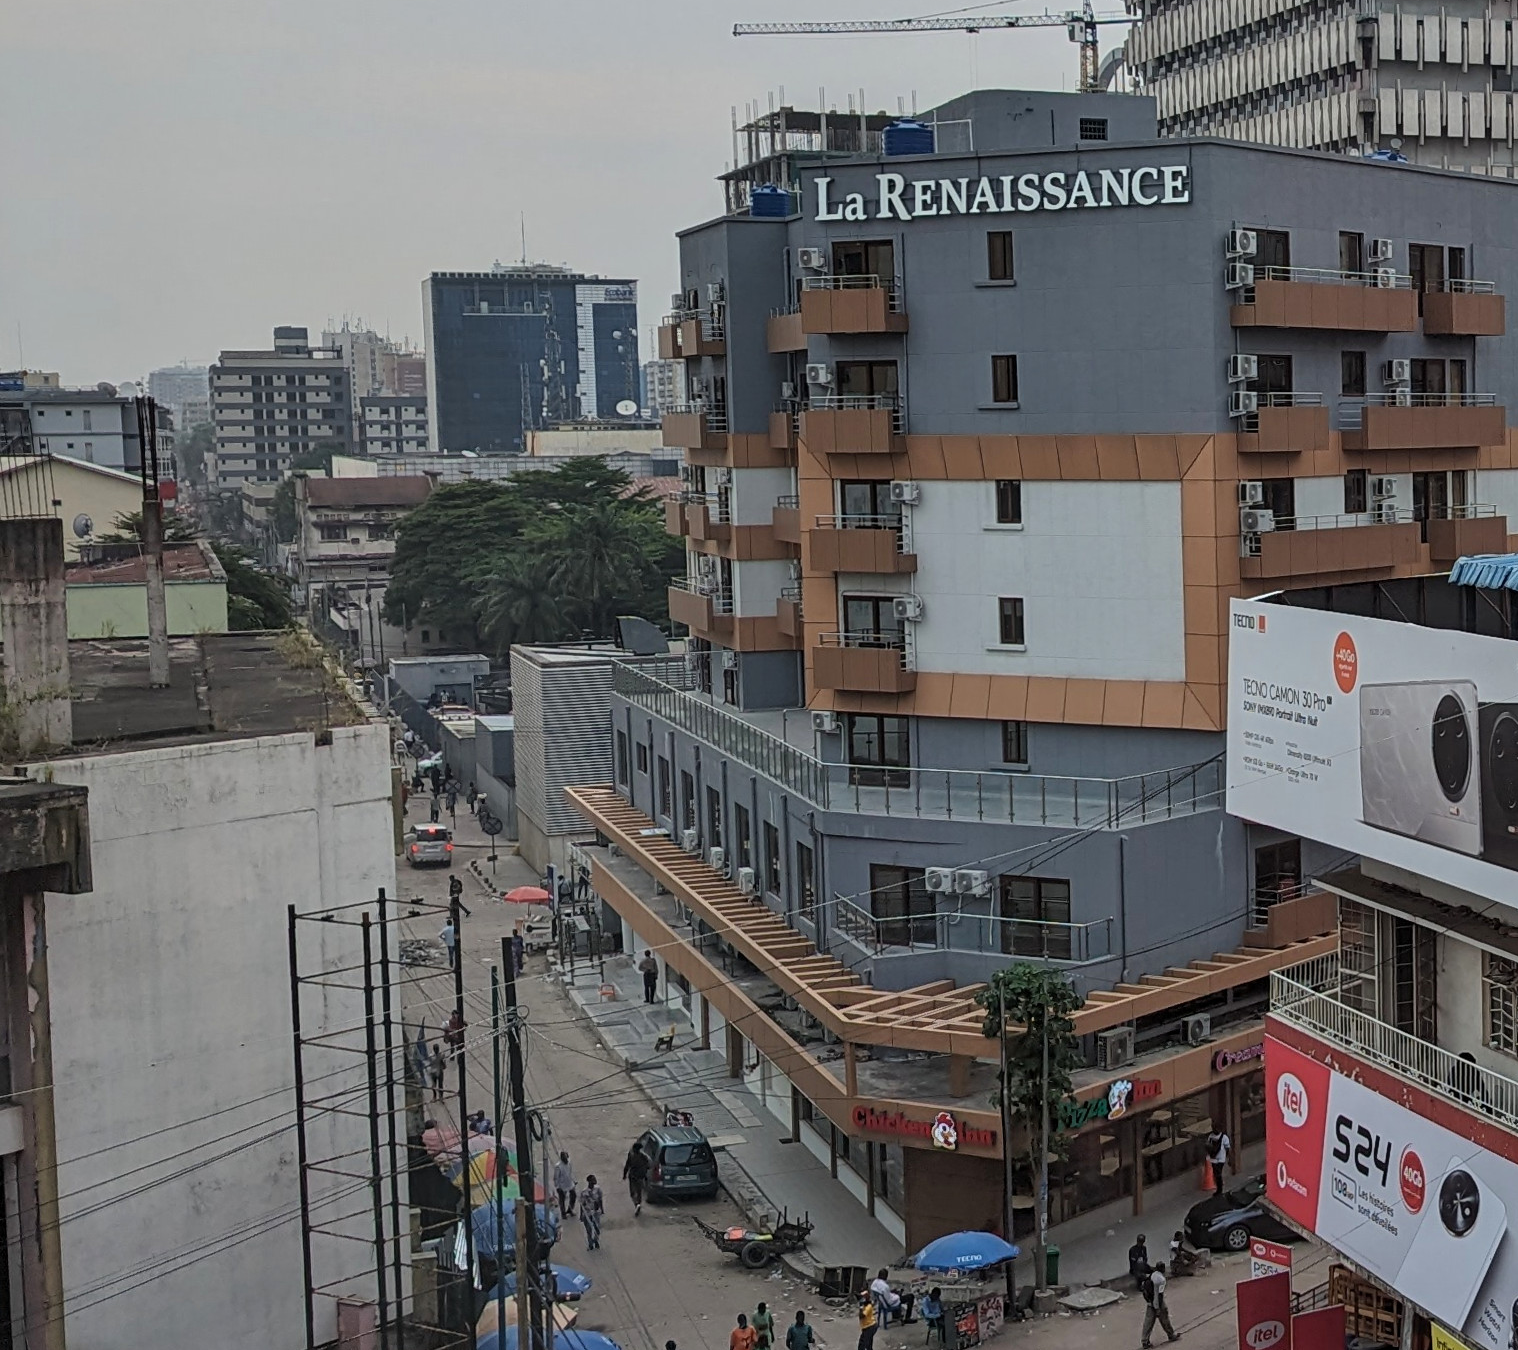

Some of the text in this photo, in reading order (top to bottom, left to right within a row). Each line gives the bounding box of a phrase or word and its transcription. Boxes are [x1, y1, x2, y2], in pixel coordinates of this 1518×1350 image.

[814, 165, 1189, 221] La RENAISSANCE
[1233, 614, 1255, 629] TECNO
[1243, 678, 1268, 698] TECNO
[1270, 684, 1300, 706] CAMON
[1302, 690, 1312, 708] 30
[1313, 692, 1326, 711] Pro
[1283, 1081, 1303, 1118] itel
[852, 1105, 997, 1147] Chicken Inn
[1333, 1114, 1392, 1188] S24
[1286, 1176, 1307, 1197] vodacom
[1357, 1204, 1371, 1218] sont
[1358, 1186, 1369, 1202] Les
[1369, 1191, 1394, 1218] histoires
[957, 1254, 982, 1263] TECNO
[1484, 1307, 1501, 1333] Watch
[1489, 1298, 1506, 1323] Smart
[1253, 1326, 1278, 1344] itel
[1478, 1316, 1498, 1345] Horizon
